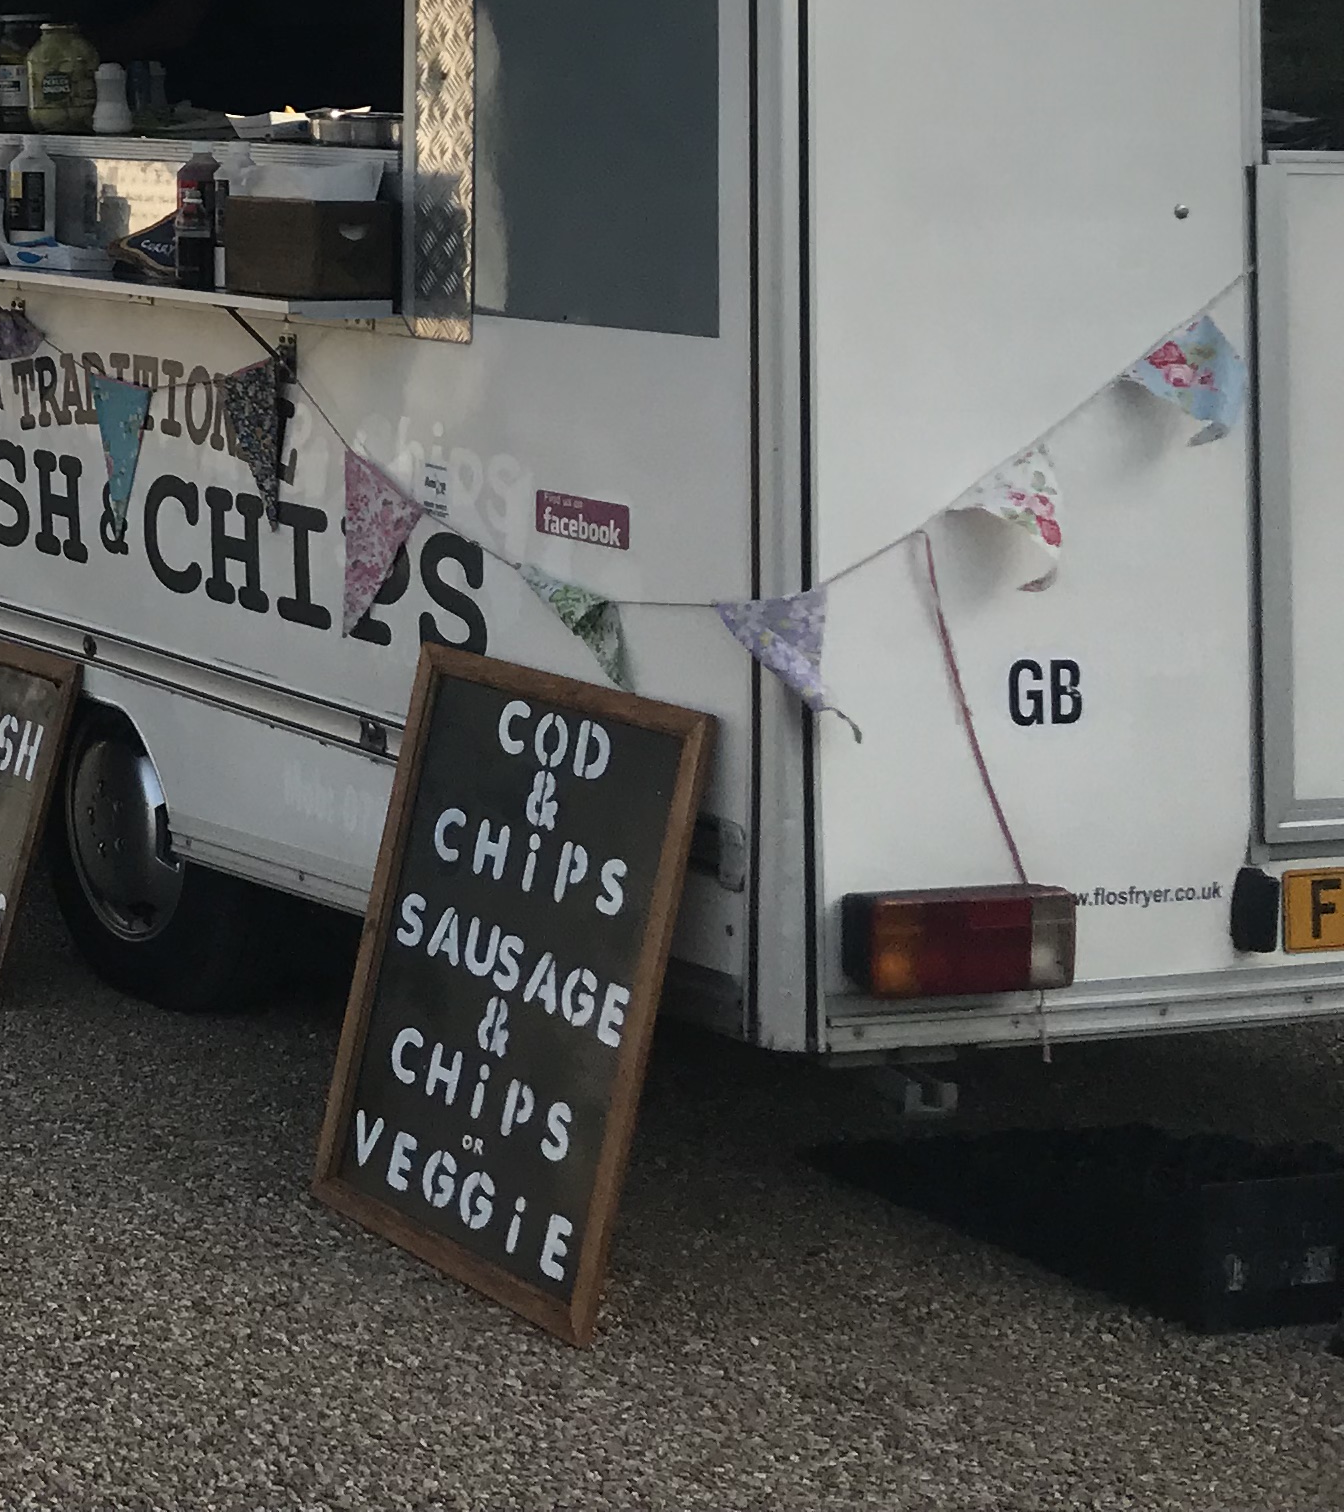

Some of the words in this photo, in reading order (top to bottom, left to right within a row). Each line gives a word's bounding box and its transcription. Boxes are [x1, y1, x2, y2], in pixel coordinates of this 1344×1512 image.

[11, 351, 296, 486] TRADTION
[543, 506, 621, 547] facebook
[1008, 659, 1083, 727] GB
[498, 700, 610, 780] COD
[525, 771, 558, 831] &
[396, 892, 630, 1048] SAUSAGE
[477, 996, 509, 1058] &
